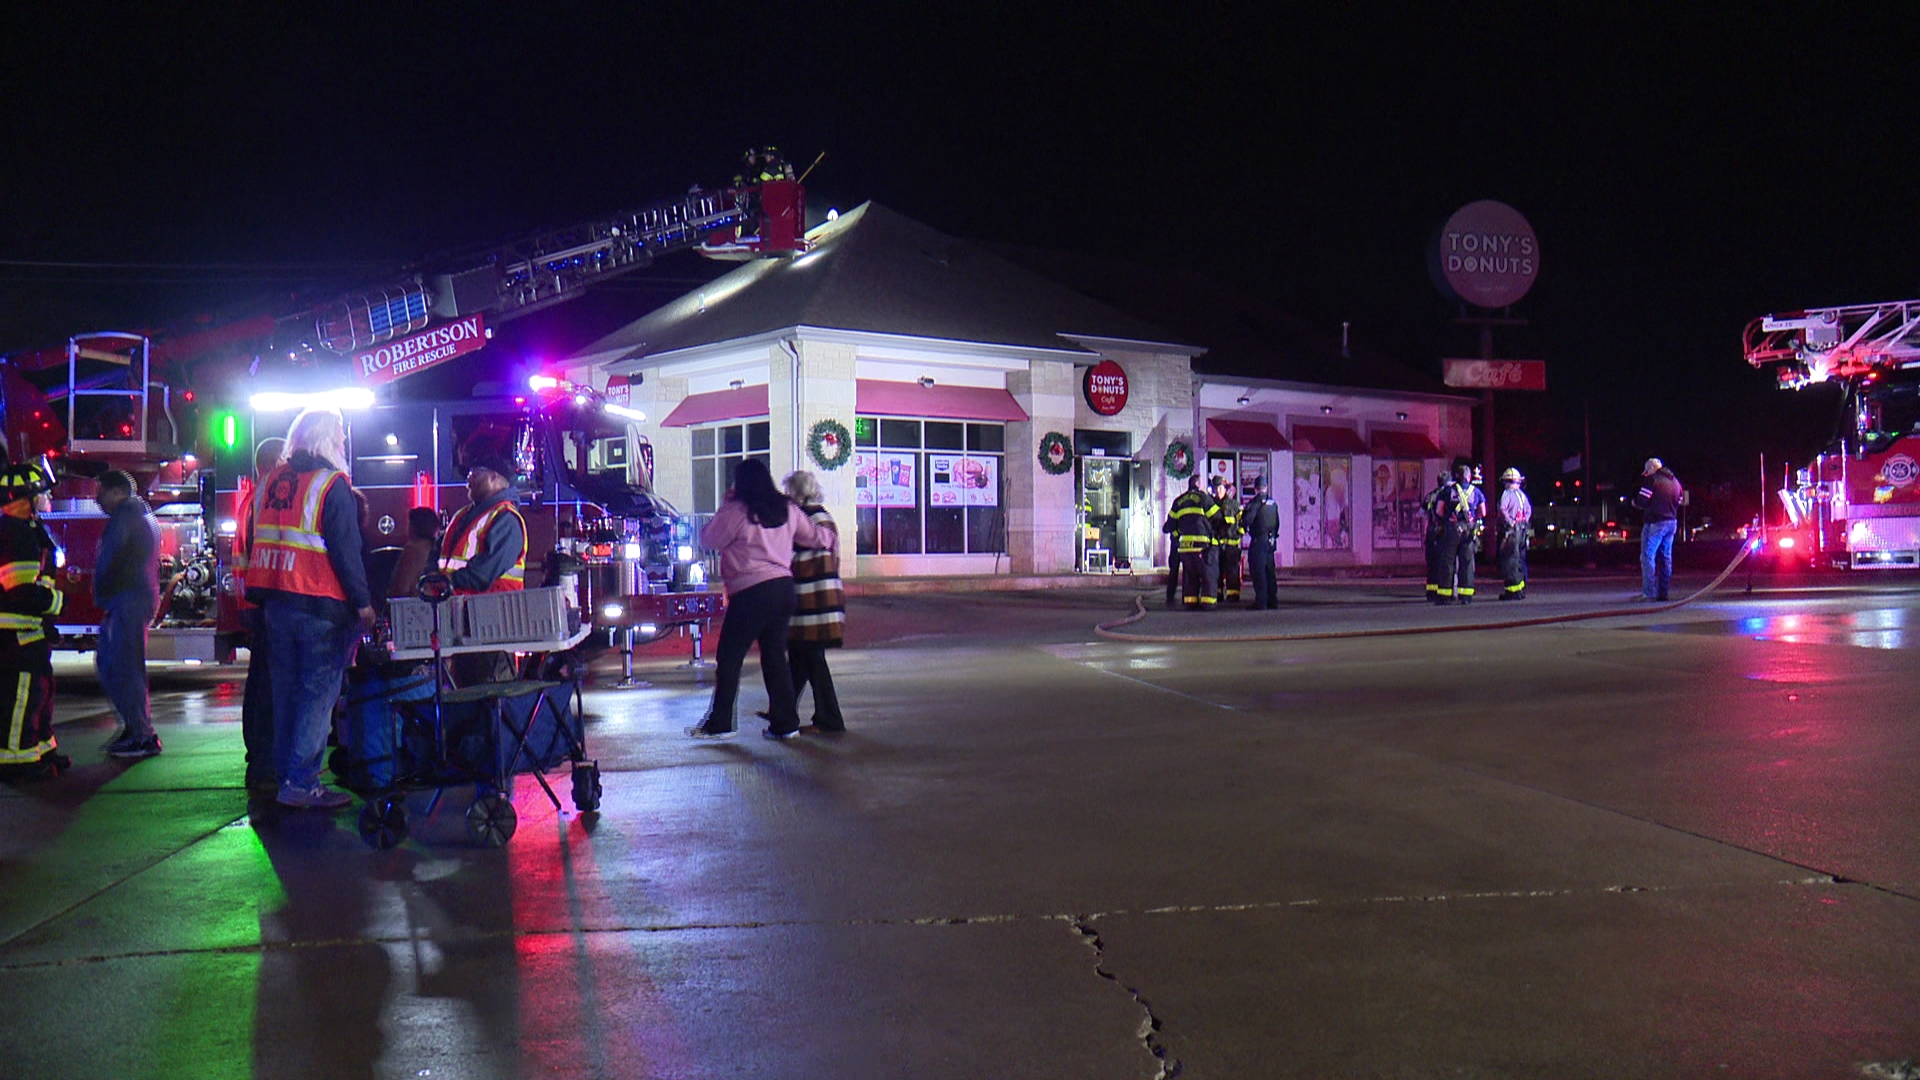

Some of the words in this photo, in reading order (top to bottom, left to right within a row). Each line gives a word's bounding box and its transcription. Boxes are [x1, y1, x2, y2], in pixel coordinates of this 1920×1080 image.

[1449, 233, 1533, 255] TONY'S
[1448, 255, 1533, 275] DONUTS
[360, 318, 479, 378] ROBERTSON
[392, 358, 417, 375] FIRE
[418, 343, 457, 366] RESCUE
[608, 384, 629, 395] TONY'S
[1091, 375, 1124, 386] TONY'S
[1091, 384, 1125, 395] DONUTS
